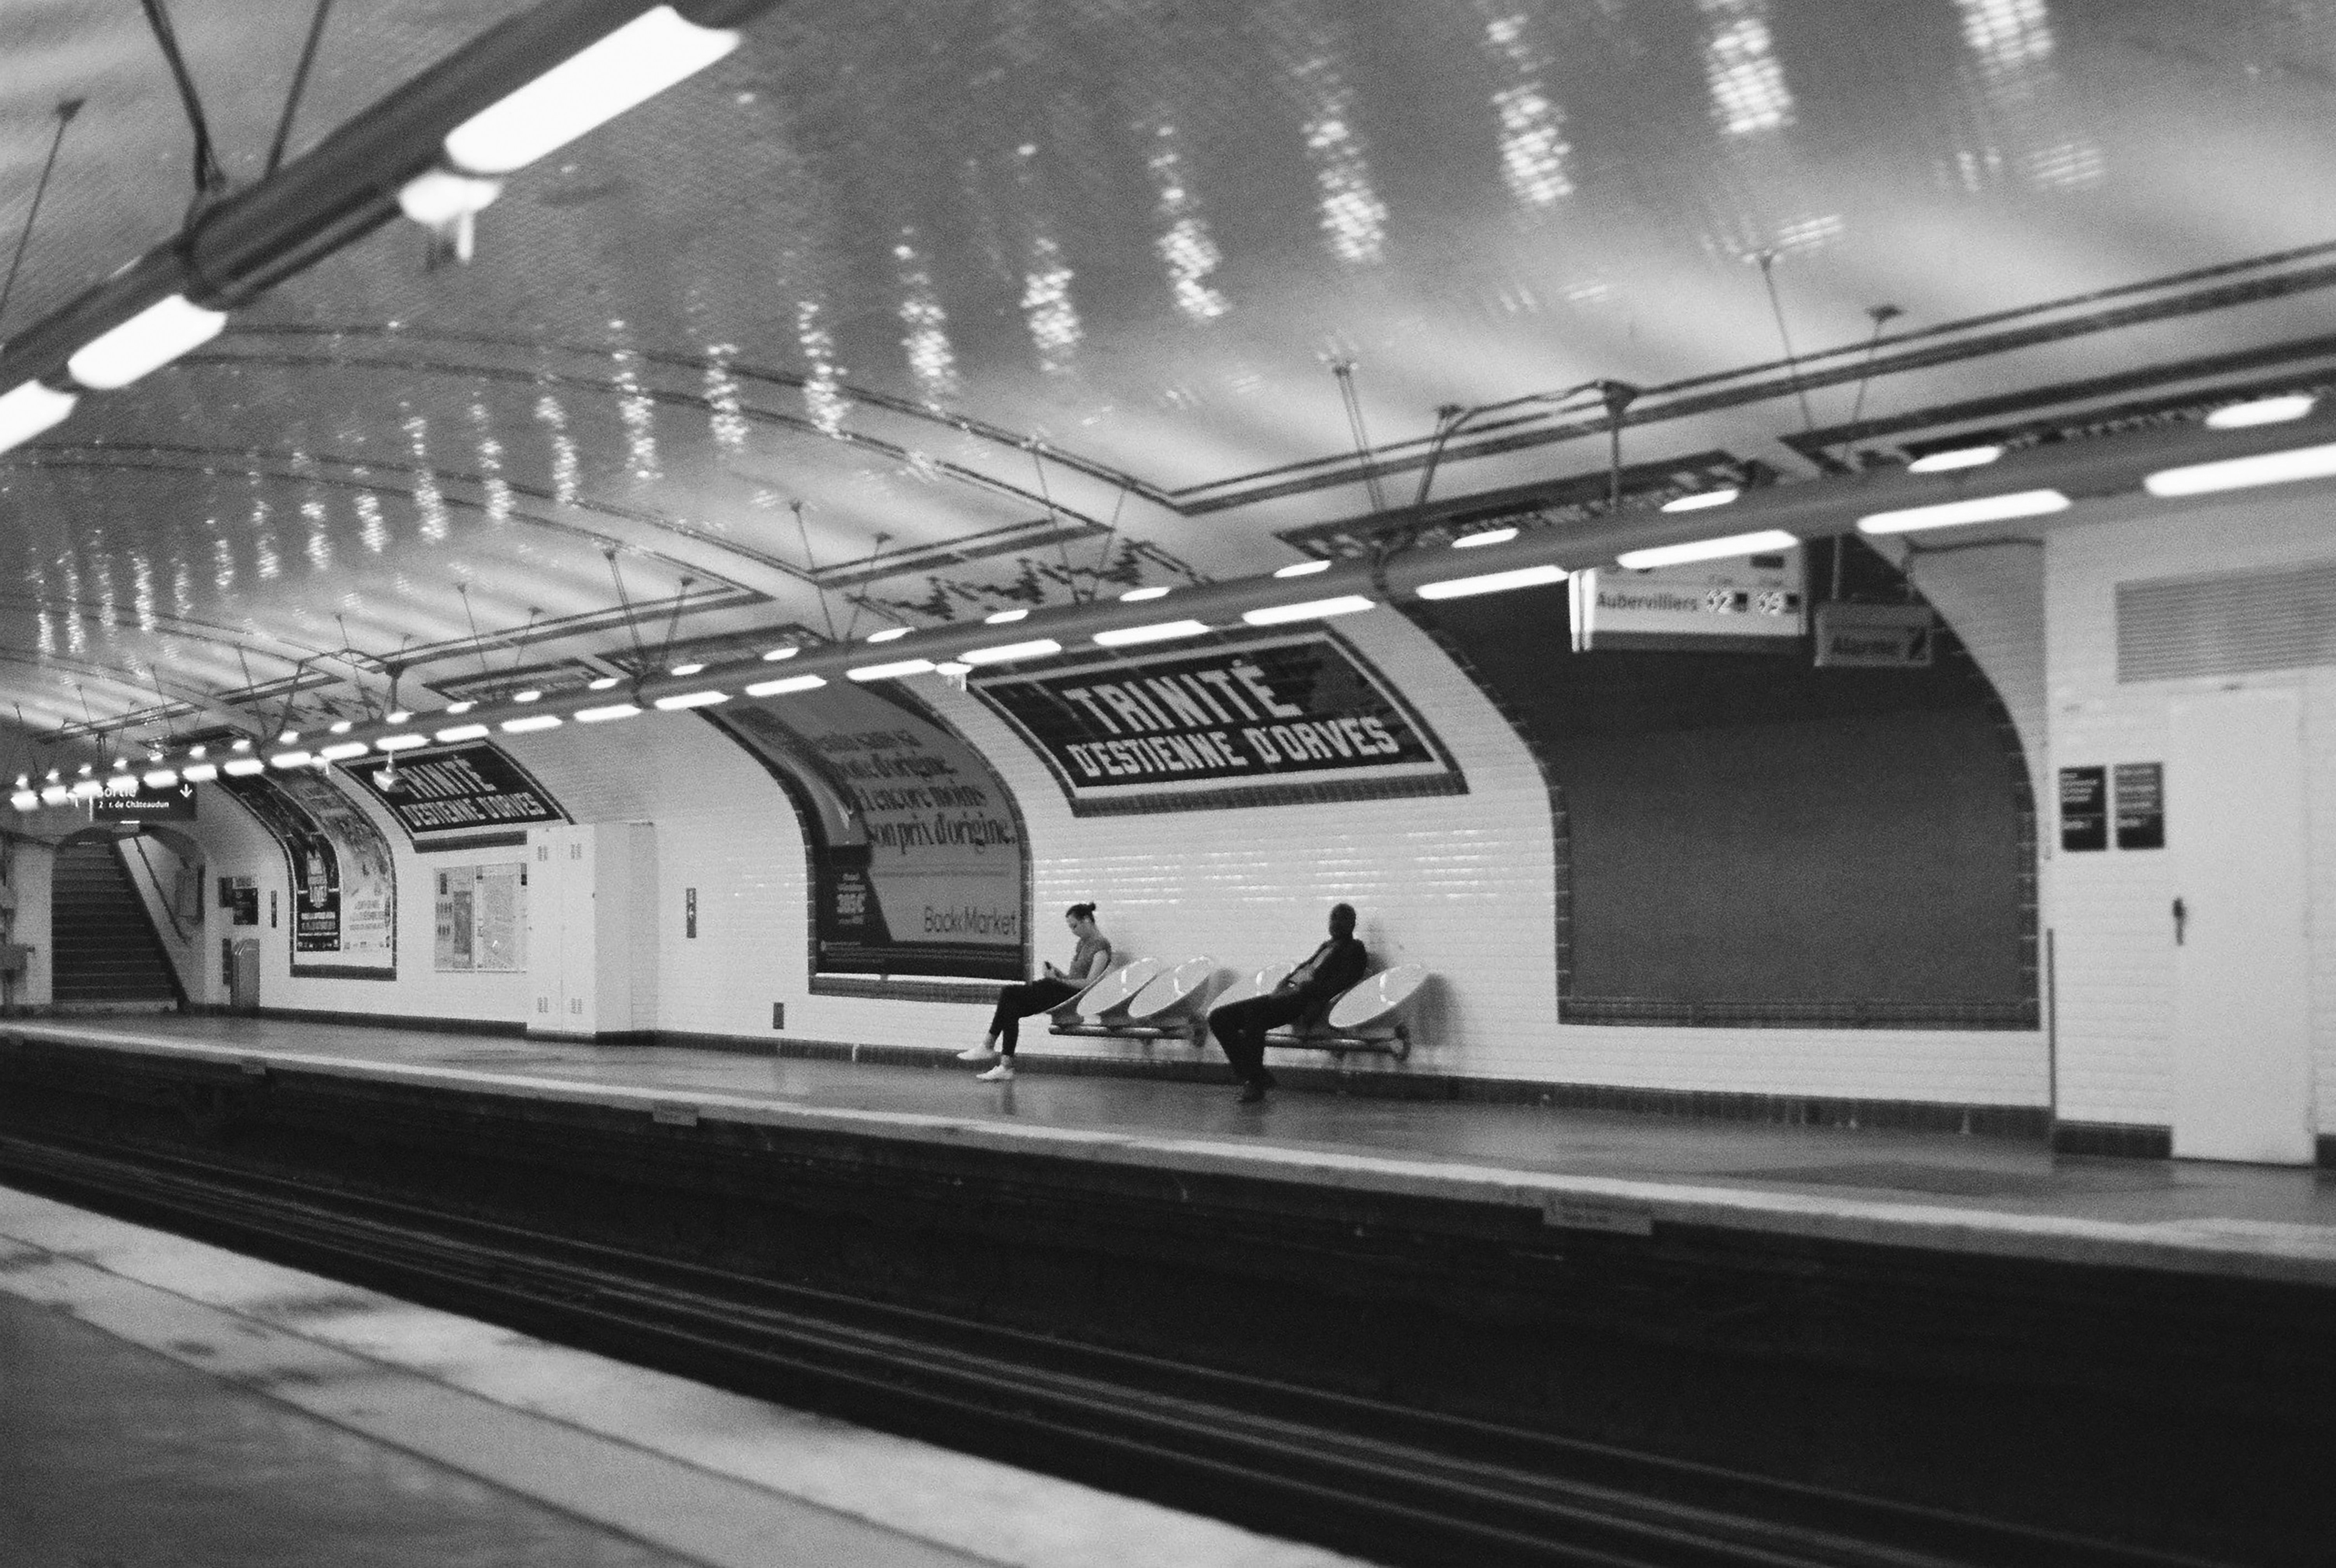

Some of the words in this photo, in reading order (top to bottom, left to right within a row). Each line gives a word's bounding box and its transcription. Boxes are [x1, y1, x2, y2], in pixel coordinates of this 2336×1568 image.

[1597, 591, 1697, 612] Aubervilliers
[1062, 659, 1303, 734] TRINITÉ
[1066, 731, 1249, 777] D'ESTIENNE
[1242, 716, 1400, 764] D'ORVES
[125, 799, 169, 809] Châteaudun
